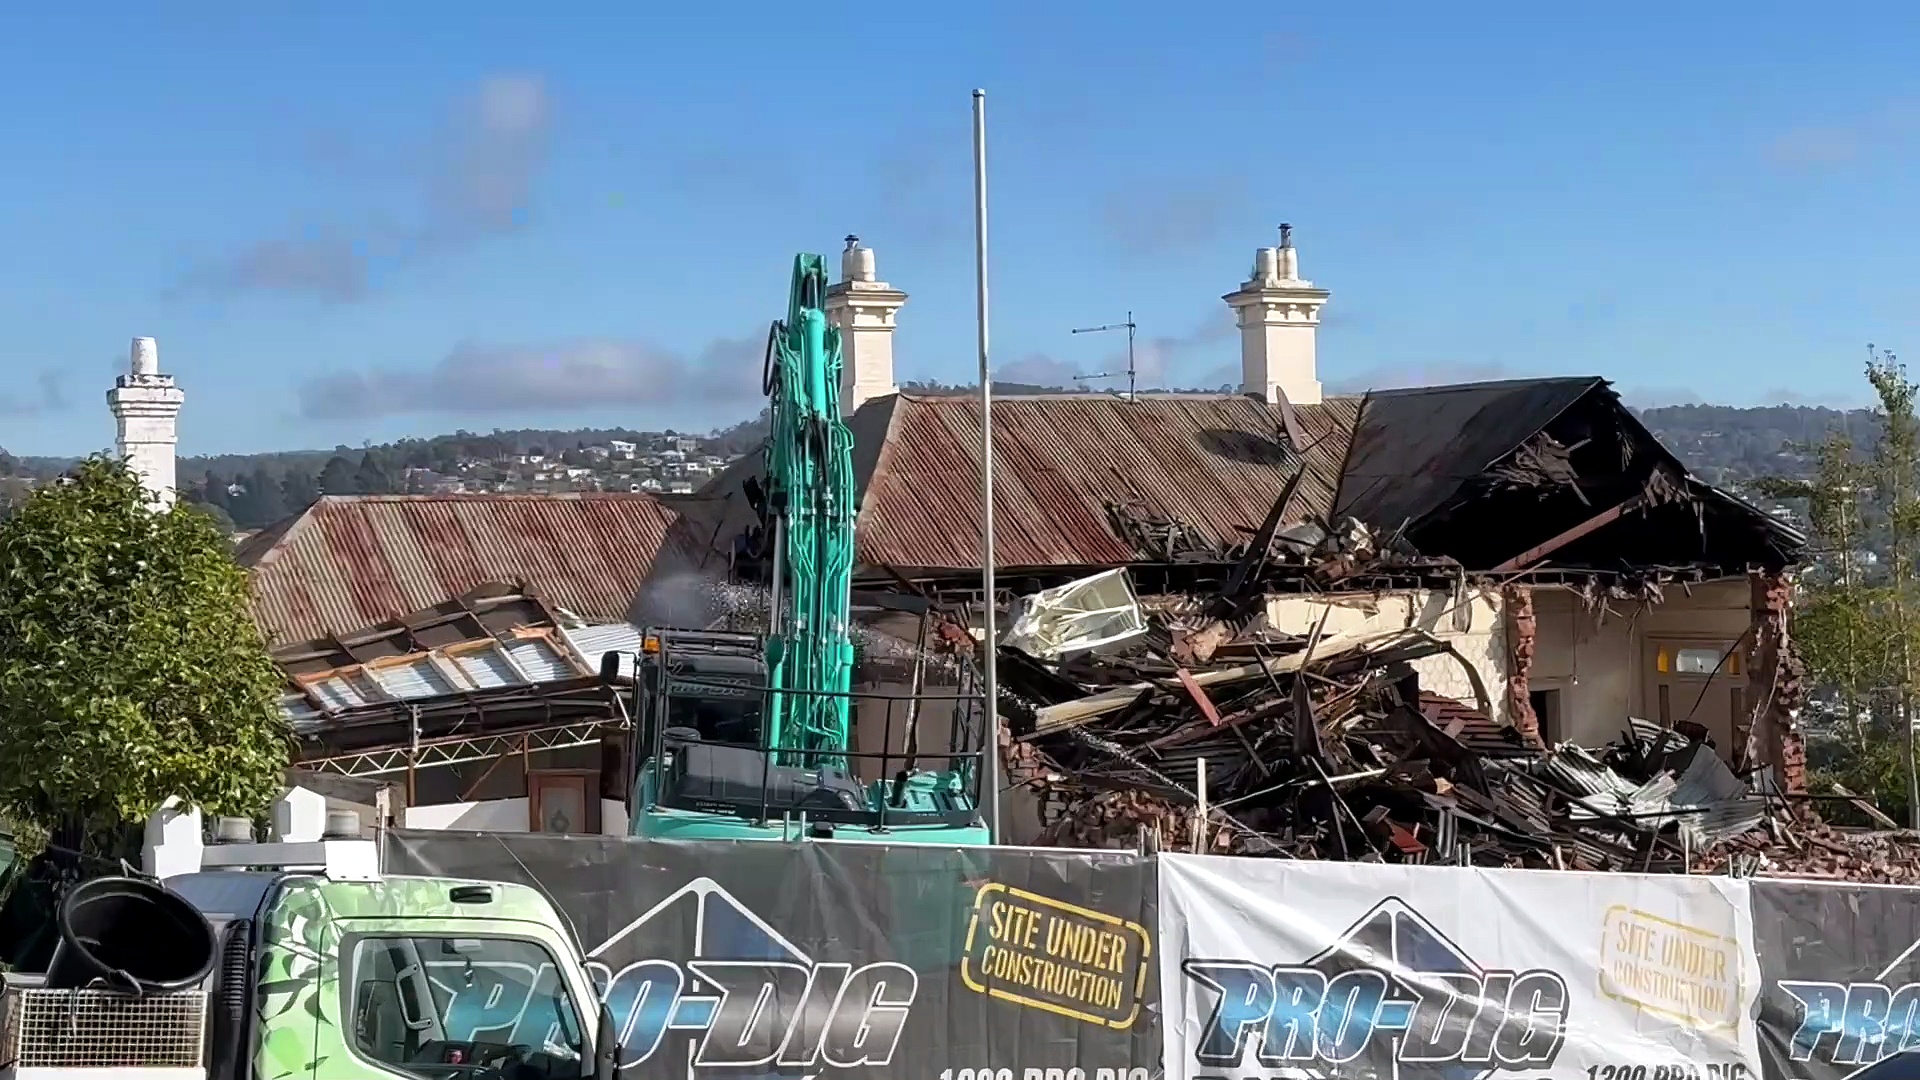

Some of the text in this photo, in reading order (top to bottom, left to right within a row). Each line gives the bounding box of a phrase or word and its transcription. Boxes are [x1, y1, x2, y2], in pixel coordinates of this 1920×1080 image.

[988, 901, 1127, 974] SITE UNDER
[1616, 921, 1727, 982] SITE UNDER
[981, 945, 1123, 1010] CONSTRUCTION
[1613, 959, 1728, 1014] CONSTRUCTION
[1181, 959, 1571, 1071] PRO-DIG
